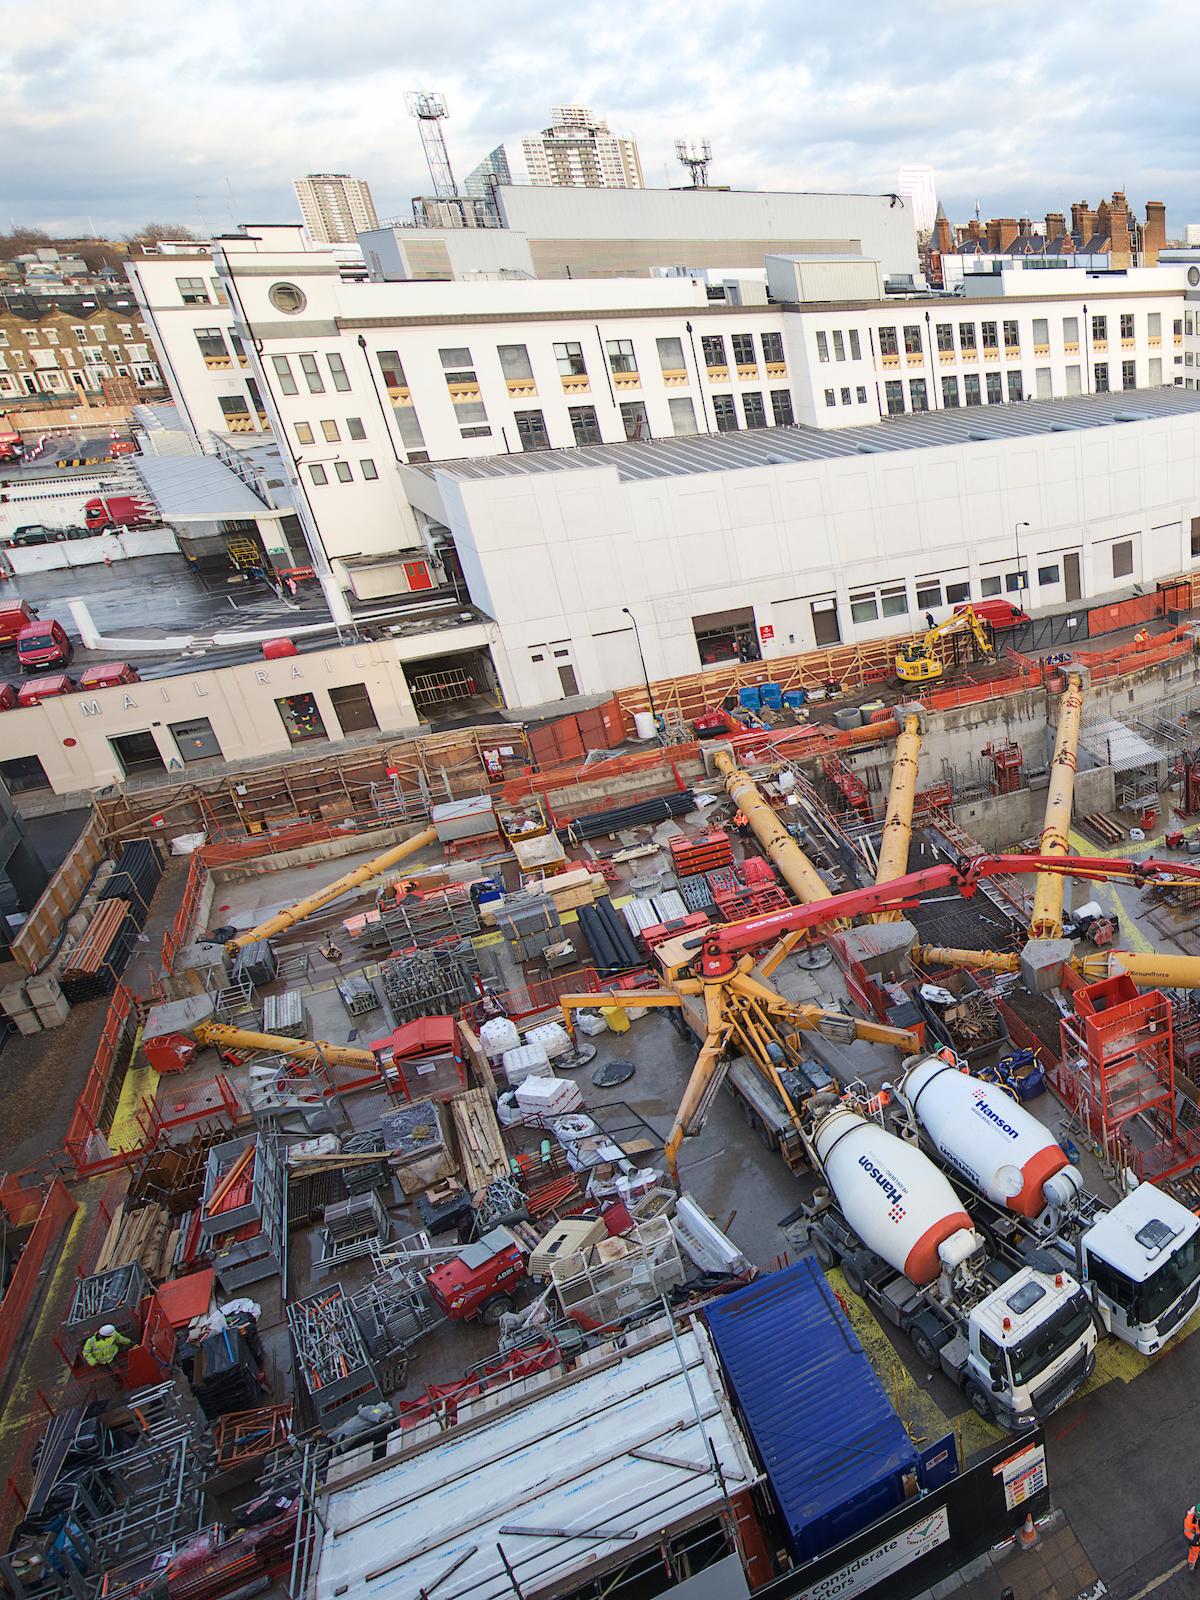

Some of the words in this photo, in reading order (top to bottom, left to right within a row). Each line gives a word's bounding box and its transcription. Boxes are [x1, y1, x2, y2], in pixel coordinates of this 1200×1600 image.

[79, 681, 208, 717] MAIL
[255, 653, 366, 686] RAIL
[975, 1099, 1019, 1140] Hanson
[858, 1155, 903, 1206] Hanson
[497, 1268, 514, 1282] ABBI
[812, 1540, 898, 1596] considerate
